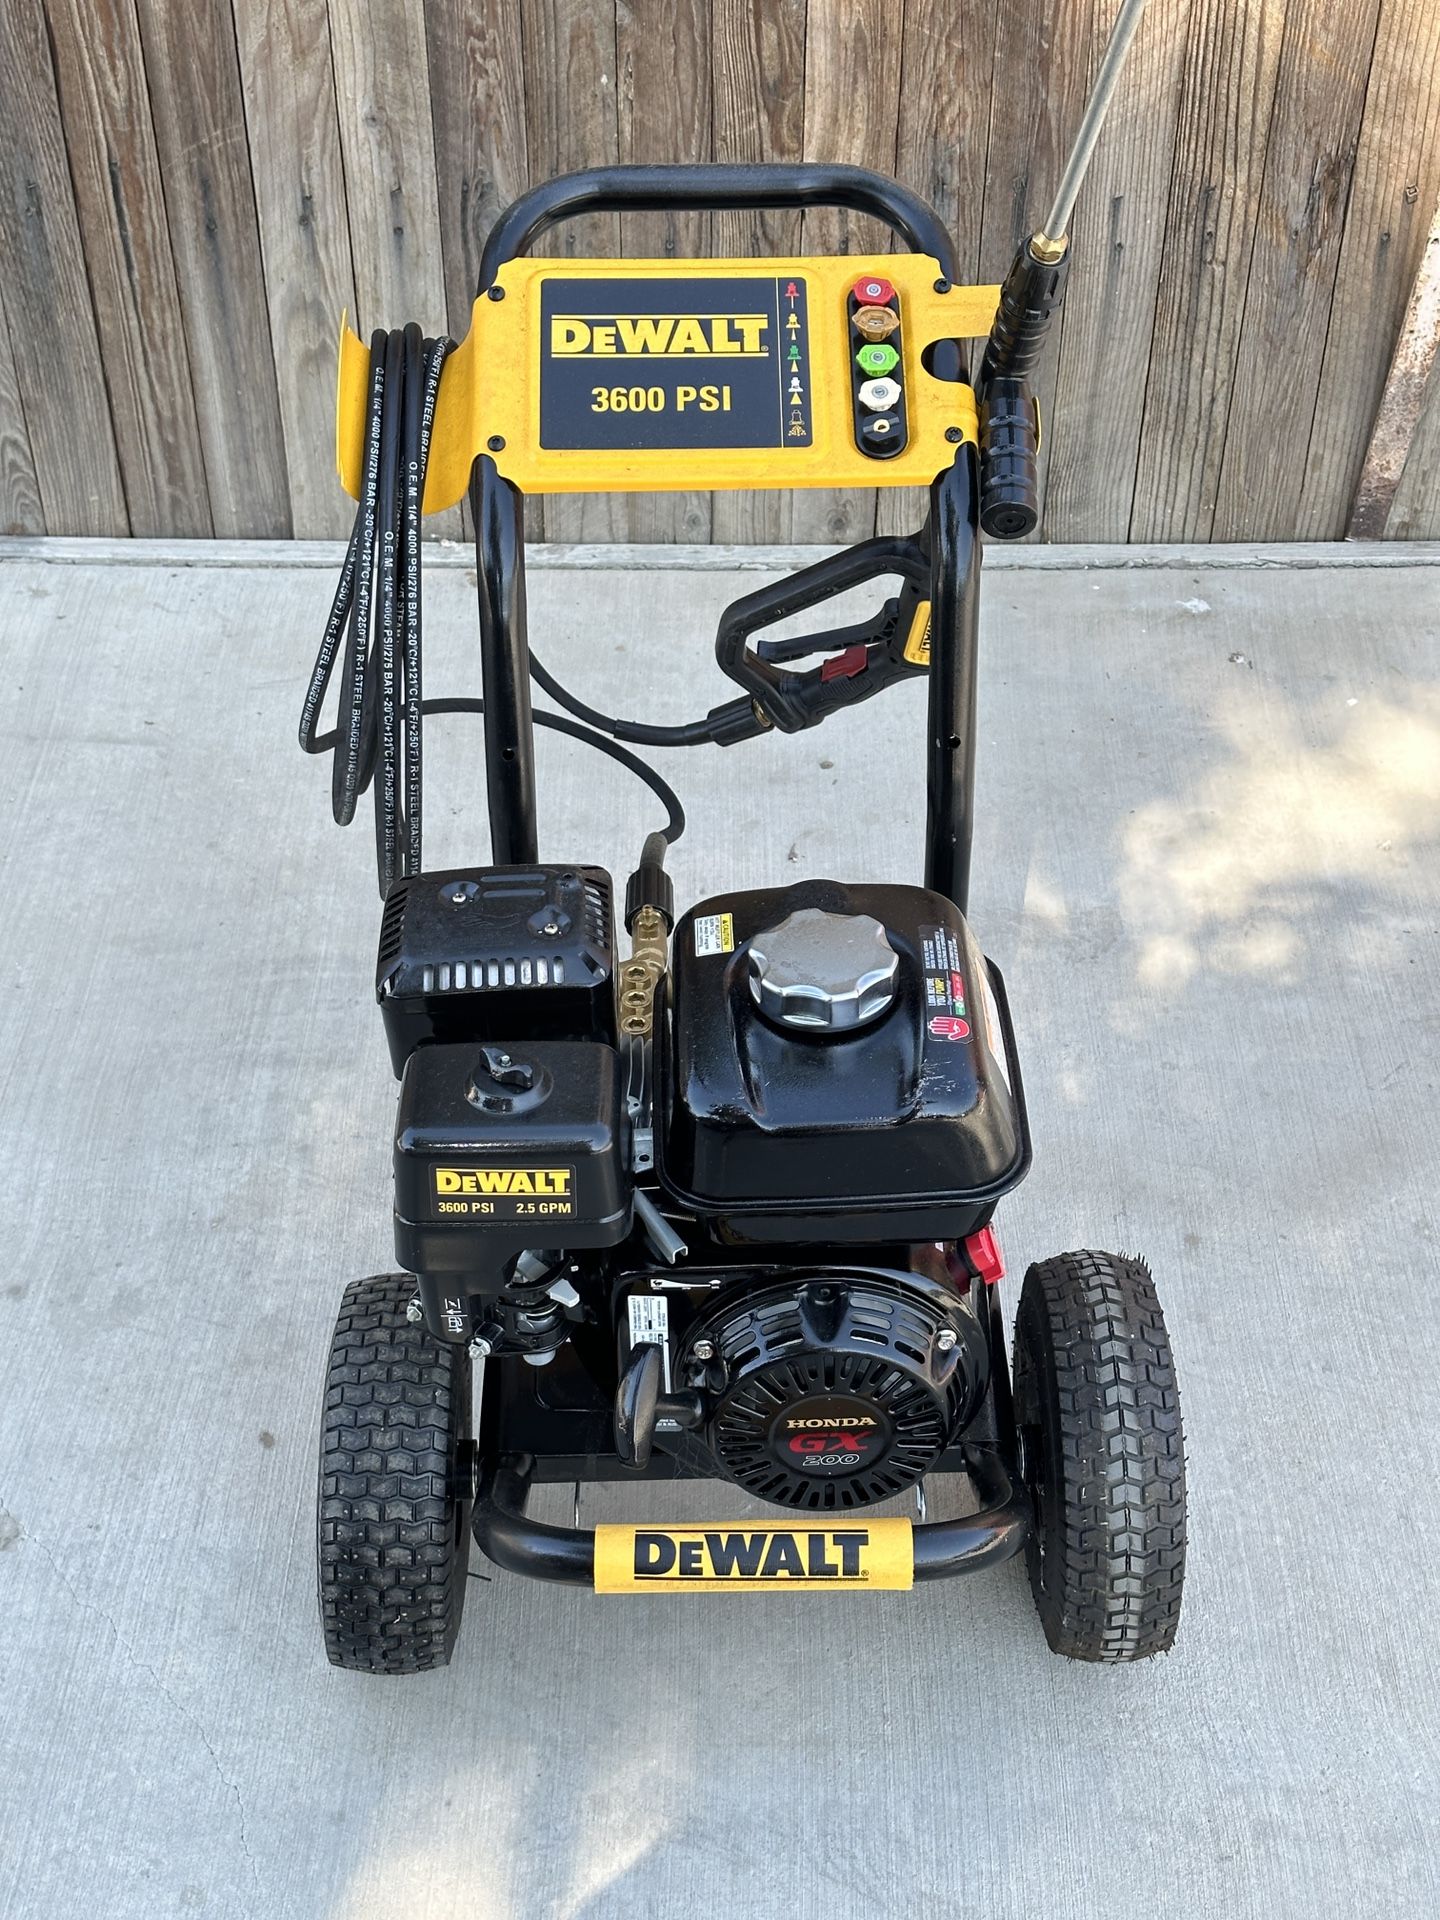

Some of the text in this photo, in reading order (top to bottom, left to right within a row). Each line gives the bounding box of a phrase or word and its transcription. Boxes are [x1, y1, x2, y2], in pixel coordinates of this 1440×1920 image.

[373, 366, 385, 394] O.E.M.
[421, 394, 435, 428] STEEL
[590, 384, 732, 413] 3600 PSI
[371, 416, 382, 439] 4000
[369, 440, 380, 479] PSI/276
[366, 481, 377, 507] BAR
[408, 461, 419, 500] O.E.M.
[384, 530, 395, 570] O.E.M.
[408, 528, 418, 555] 4000
[407, 557, 418, 599] PSI/276
[384, 599, 394, 627] 4000
[408, 601, 418, 626] BAR
[319, 636, 336, 665] STEEL
[355, 653, 366, 677] R-1
[309, 667, 328, 703] BRAIDED
[352, 676, 364, 706] STEEL
[383, 671, 394, 695] BAR
[349, 708, 362, 750] BRAIDED
[409, 764, 419, 781] R-1
[409, 783, 420, 815] STEEL
[410, 816, 420, 855] BRAIDED
[936, 995, 947, 1007] YOU
[438, 1202, 572, 1214] 3600 PSI 2.5 GPM
[786, 1417, 878, 1429] HONDA
[788, 1431, 873, 1453] GX
[802, 1453, 860, 1467] 200
